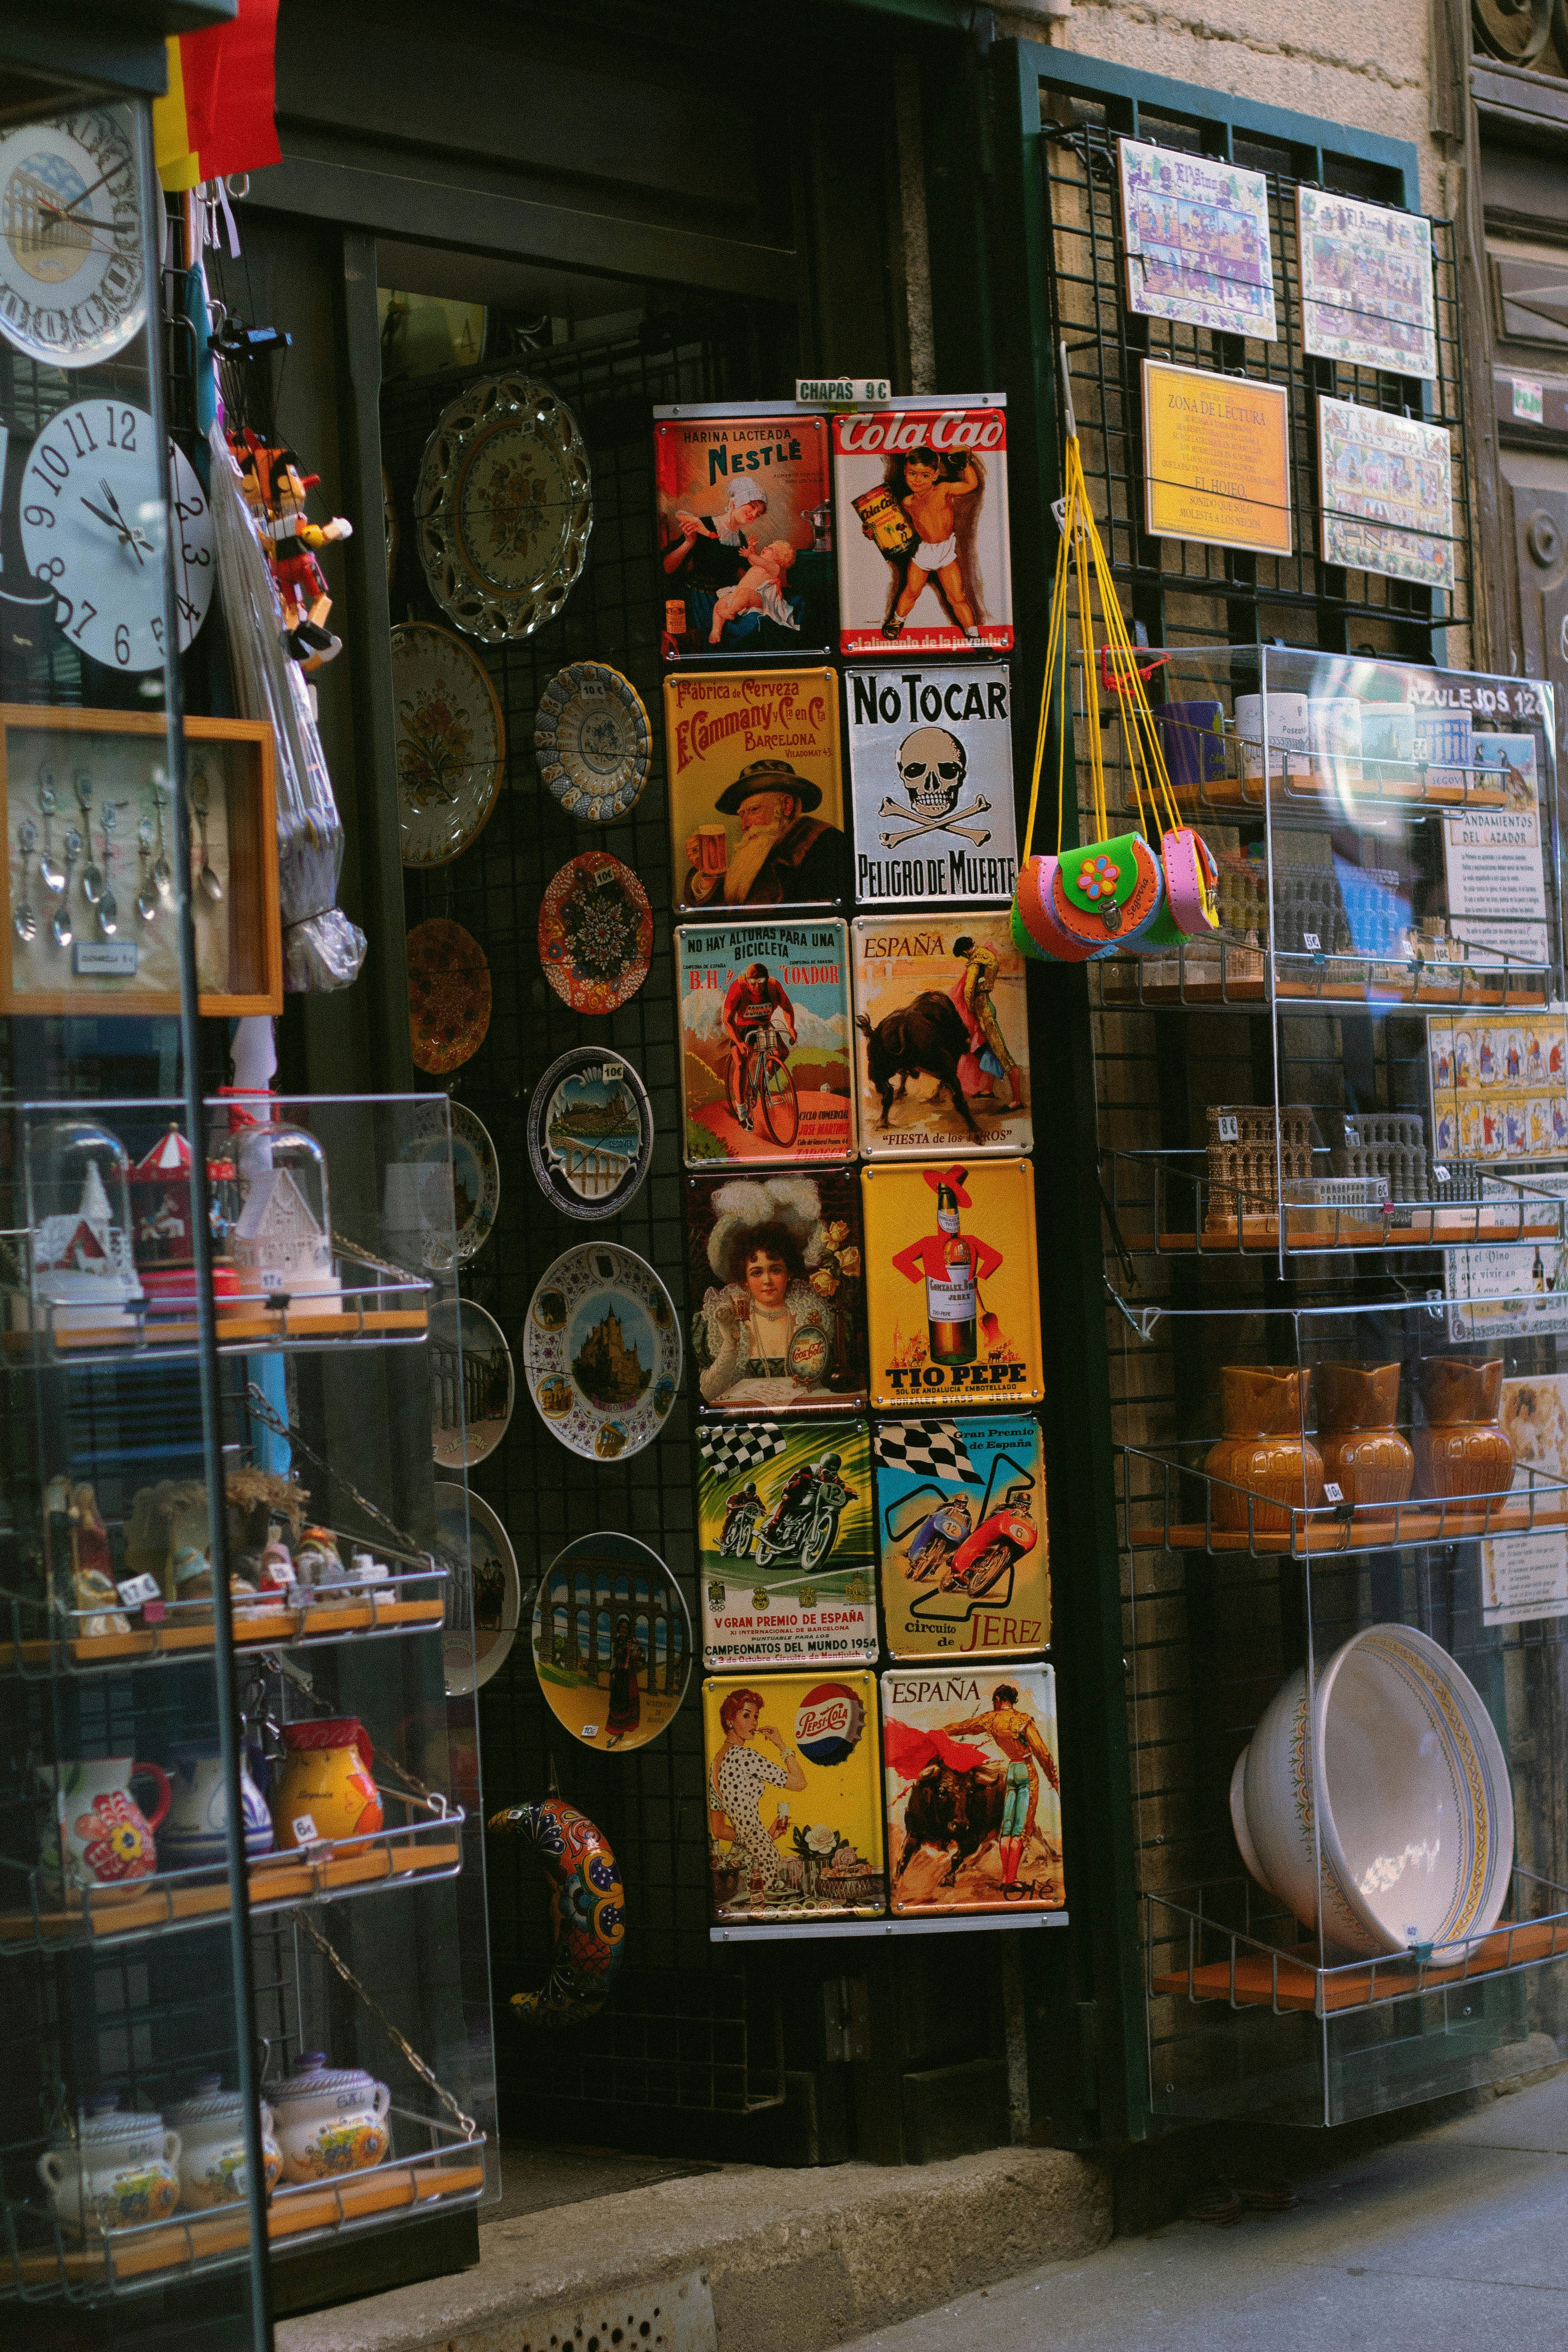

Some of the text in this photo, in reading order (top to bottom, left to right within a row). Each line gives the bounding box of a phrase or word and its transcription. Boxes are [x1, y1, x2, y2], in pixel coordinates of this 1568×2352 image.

[800, 382, 853, 400] CHAPAS
[1168, 395, 1198, 413] ZONA
[1201, 401, 1215, 416] DE
[1218, 404, 1266, 426] LECTURA
[107, 407, 136, 452] 12
[684, 429, 791, 443] HARINA LACTEADA
[709, 438, 802, 485] NESTLÉ
[864, 635, 916, 649] alimento
[676, 678, 799, 708] Fábrica de Cerveza
[851, 674, 1009, 724] NO TOCAR
[1406, 687, 1510, 714] AZULEJOS
[796, 706, 808, 720] en
[744, 730, 816, 751] BARCELONA
[785, 750, 821, 758] VILADOMAT
[1455, 815, 1533, 828] ANDAMIENTOS
[1463, 831, 1480, 843] DEL
[598, 870, 612, 882] 10€
[858, 849, 1016, 898] PELIGRO DE MUERTE
[1127, 877, 1149, 920] Segovia
[688, 927, 834, 953] NO HAY ALTURAS PARA UNA
[864, 933, 945, 959] ESPAÑA
[735, 942, 789, 961] BICICLETA
[605, 1067, 622, 1077] 10€
[799, 1111, 817, 1120] CICLO
[933, 1132, 945, 1143] de
[948, 1132, 962, 1143] los
[886, 1363, 1026, 1388] TIO PEPE
[953, 1427, 1034, 1439] Gran Premio
[970, 1438, 1032, 1450] de España
[826, 1484, 841, 1502] 12
[946, 1522, 957, 1534] 12
[1015, 1527, 1024, 1538] 6
[715, 1610, 864, 1628] V GRAN PREMIO DE ESPAÑA
[905, 1613, 1042, 1652] circuito JEREZ
[937, 1637, 955, 1646] de
[705, 1638, 877, 1656] CAMPEONATOS DEL MUNDO 1954
[892, 1677, 981, 1704] ESPAÑA
[1002, 1876, 1054, 1902] Olé
